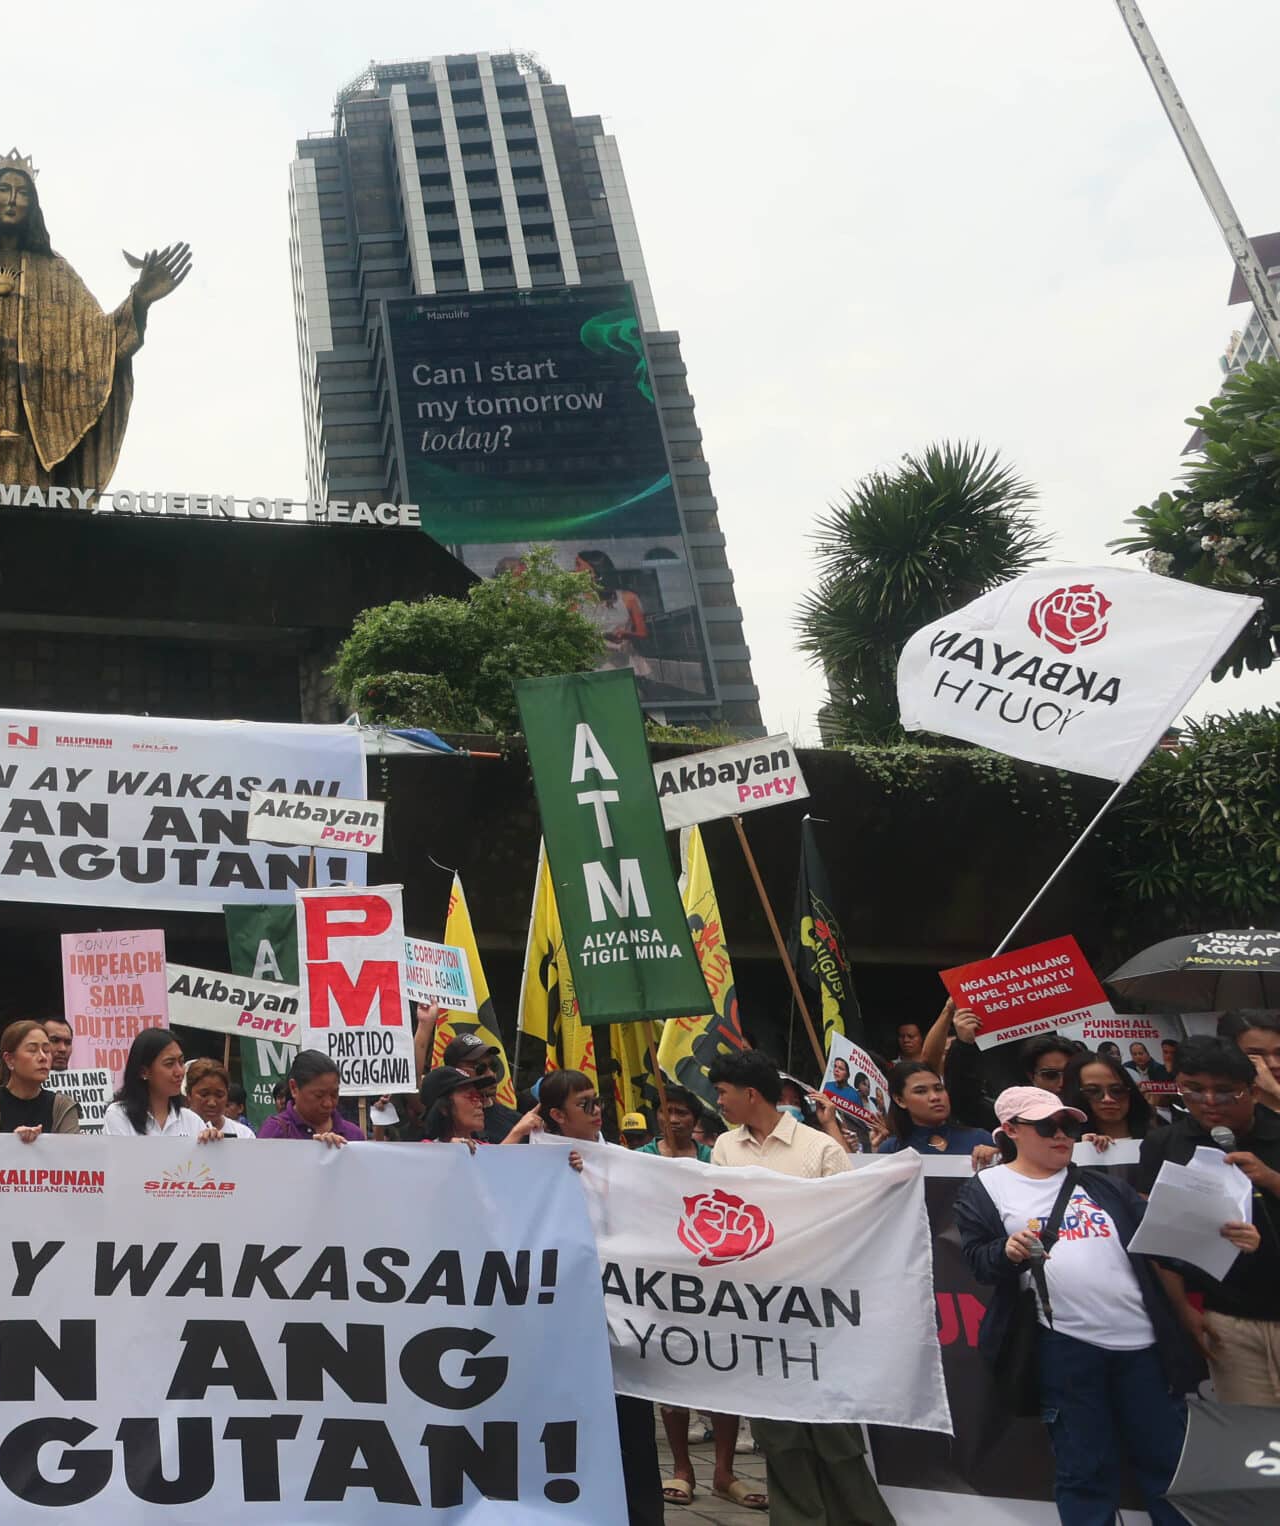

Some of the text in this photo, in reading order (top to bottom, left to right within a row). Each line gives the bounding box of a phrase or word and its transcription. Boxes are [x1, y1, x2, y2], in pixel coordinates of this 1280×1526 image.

[427, 310, 469, 320] Manulife
[413, 359, 558, 385] Can I start
[417, 392, 603, 421] my tomorrow
[421, 425, 513, 454] today?
[113, 489, 235, 518] QUEEN
[247, 497, 293, 519] OF
[306, 500, 421, 526] PEACE
[29, 768, 100, 794] AY
[658, 750, 790, 797] Akbayan
[737, 776, 796, 802] Party
[255, 799, 379, 827] Akbayan
[144, 806, 299, 848] AN
[320, 827, 377, 846] Party
[75, 936, 141, 952] CONVICT
[584, 930, 663, 949] ALYANSA
[70, 952, 162, 975] IMPEACH
[414, 944, 459, 968] CORRUPTION
[580, 945, 683, 966] TIGIL MINA
[81, 974, 143, 985] CONVICT
[435, 969, 465, 993] AGAIN!
[960, 954, 1071, 993] MGA BATA WALANG
[968, 967, 1075, 1004] PAPEL, SILA MAY LV
[90, 984, 144, 1006] SARA
[168, 974, 299, 1015] Akbayan
[985, 983, 1072, 1014] BAG AT CHANEL
[252, 940, 301, 1077] AM
[74, 1015, 163, 1039] DUTERTE
[237, 1012, 296, 1037] Party
[996, 1010, 1092, 1041] AKBAYAN YOUTH
[1083, 1030, 1160, 1039] PLUNDERERS
[1085, 1020, 1152, 1028] PUNISH ALL
[328, 1032, 393, 1056] PARTIDO
[82, 1071, 107, 1086] ANG
[144, 1180, 236, 1191] SIKLAB
[93, 1241, 559, 1306] WAKASAN!
[602, 1261, 861, 1327] AKBAYAN
[624, 1318, 819, 1381] YOUTH
[166, 1319, 509, 1410] ANG
